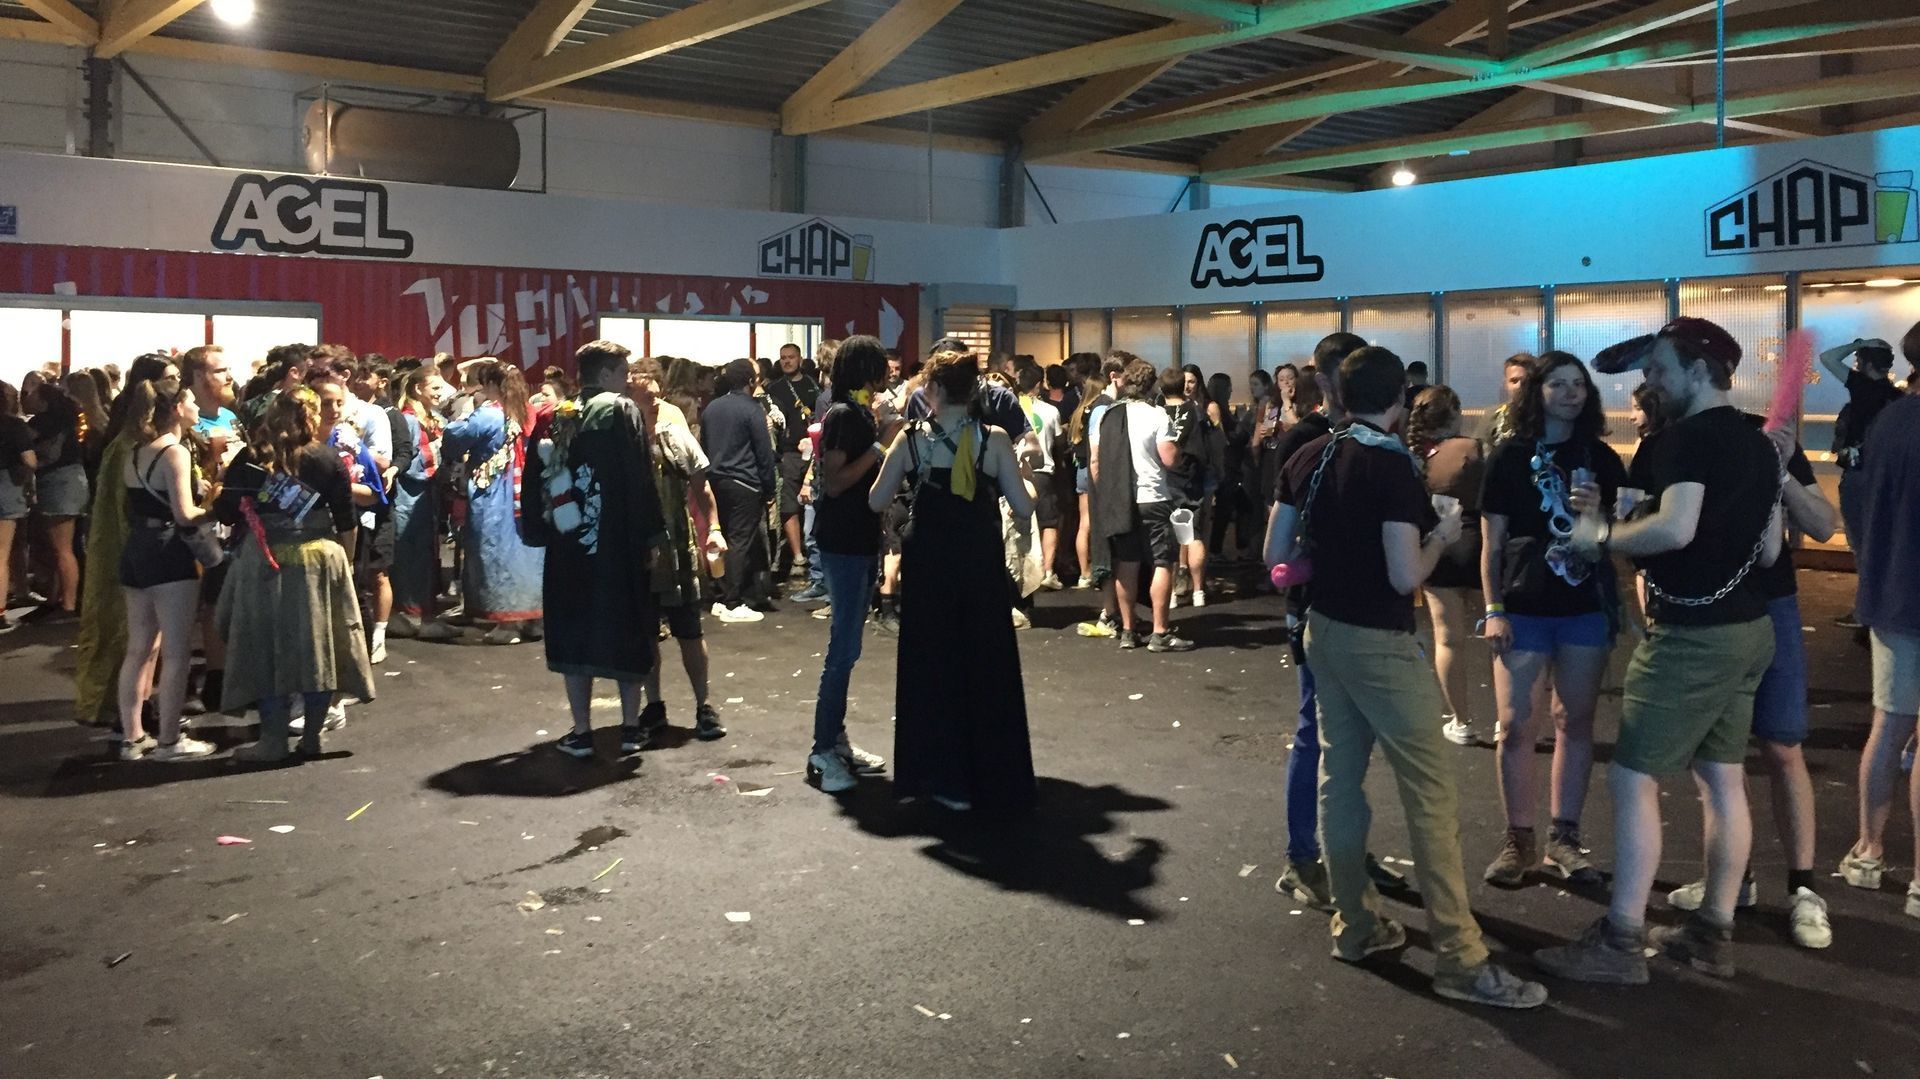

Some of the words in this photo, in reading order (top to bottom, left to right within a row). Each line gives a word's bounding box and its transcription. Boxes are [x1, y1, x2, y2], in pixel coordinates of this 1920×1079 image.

[213, 175, 412, 257] AGEL
[1711, 167, 1869, 250] CHAP
[761, 222, 850, 276] CHAP
[1193, 217, 1322, 286] AGEL
